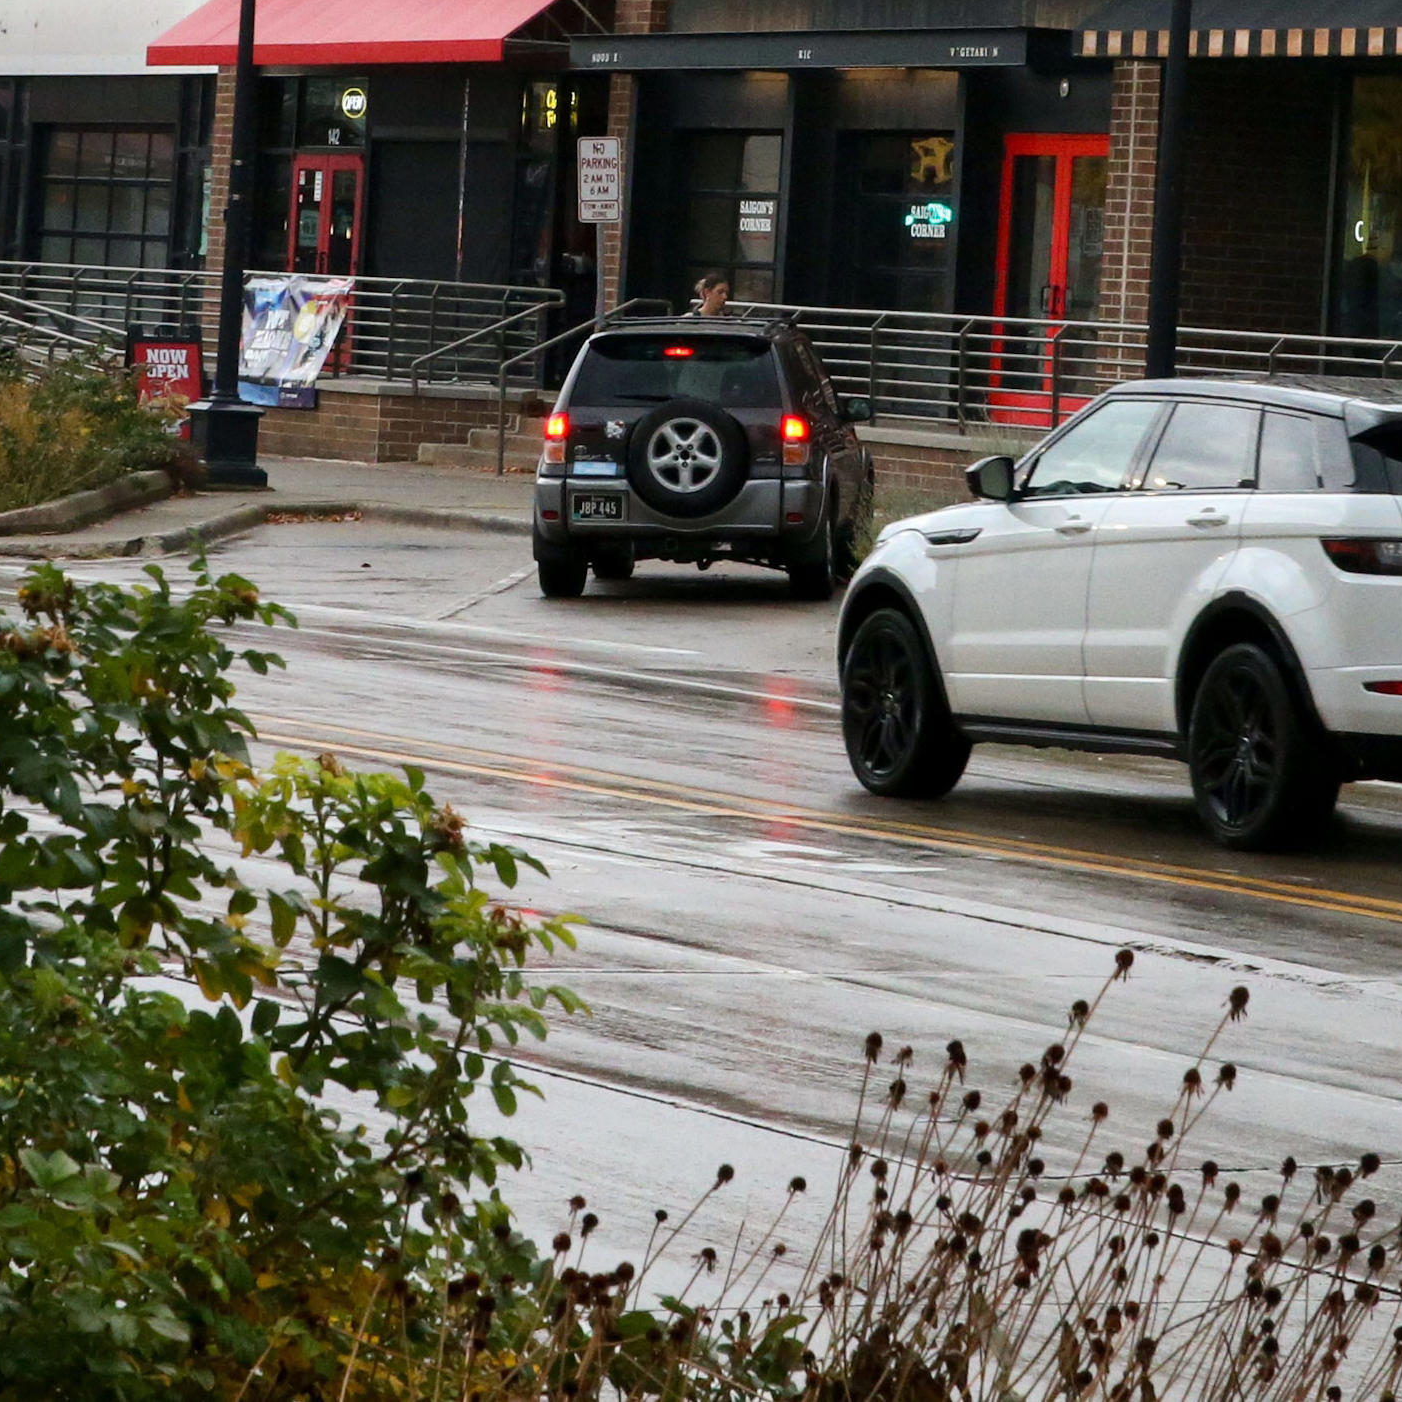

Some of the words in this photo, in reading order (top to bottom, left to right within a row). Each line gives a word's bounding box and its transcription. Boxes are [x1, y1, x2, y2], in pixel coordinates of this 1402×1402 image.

[950, 47, 998, 58] VGETARIN
[342, 95, 364, 111] OPEN
[328, 128, 341, 145] 142
[592, 142, 605, 155] NO
[581, 157, 618, 170] PARKING
[583, 174, 589, 184] 2
[591, 174, 603, 184] AM
[606, 174, 616, 184] TO
[597, 186, 609, 195] AM
[739, 201, 773, 214] SAIGON'S
[739, 218, 771, 232] CORNER
[910, 223, 946, 238] CORNER
[146, 348, 188, 364] NOW
[146, 364, 190, 379] OPEN
[598, 501, 617, 515] 445
